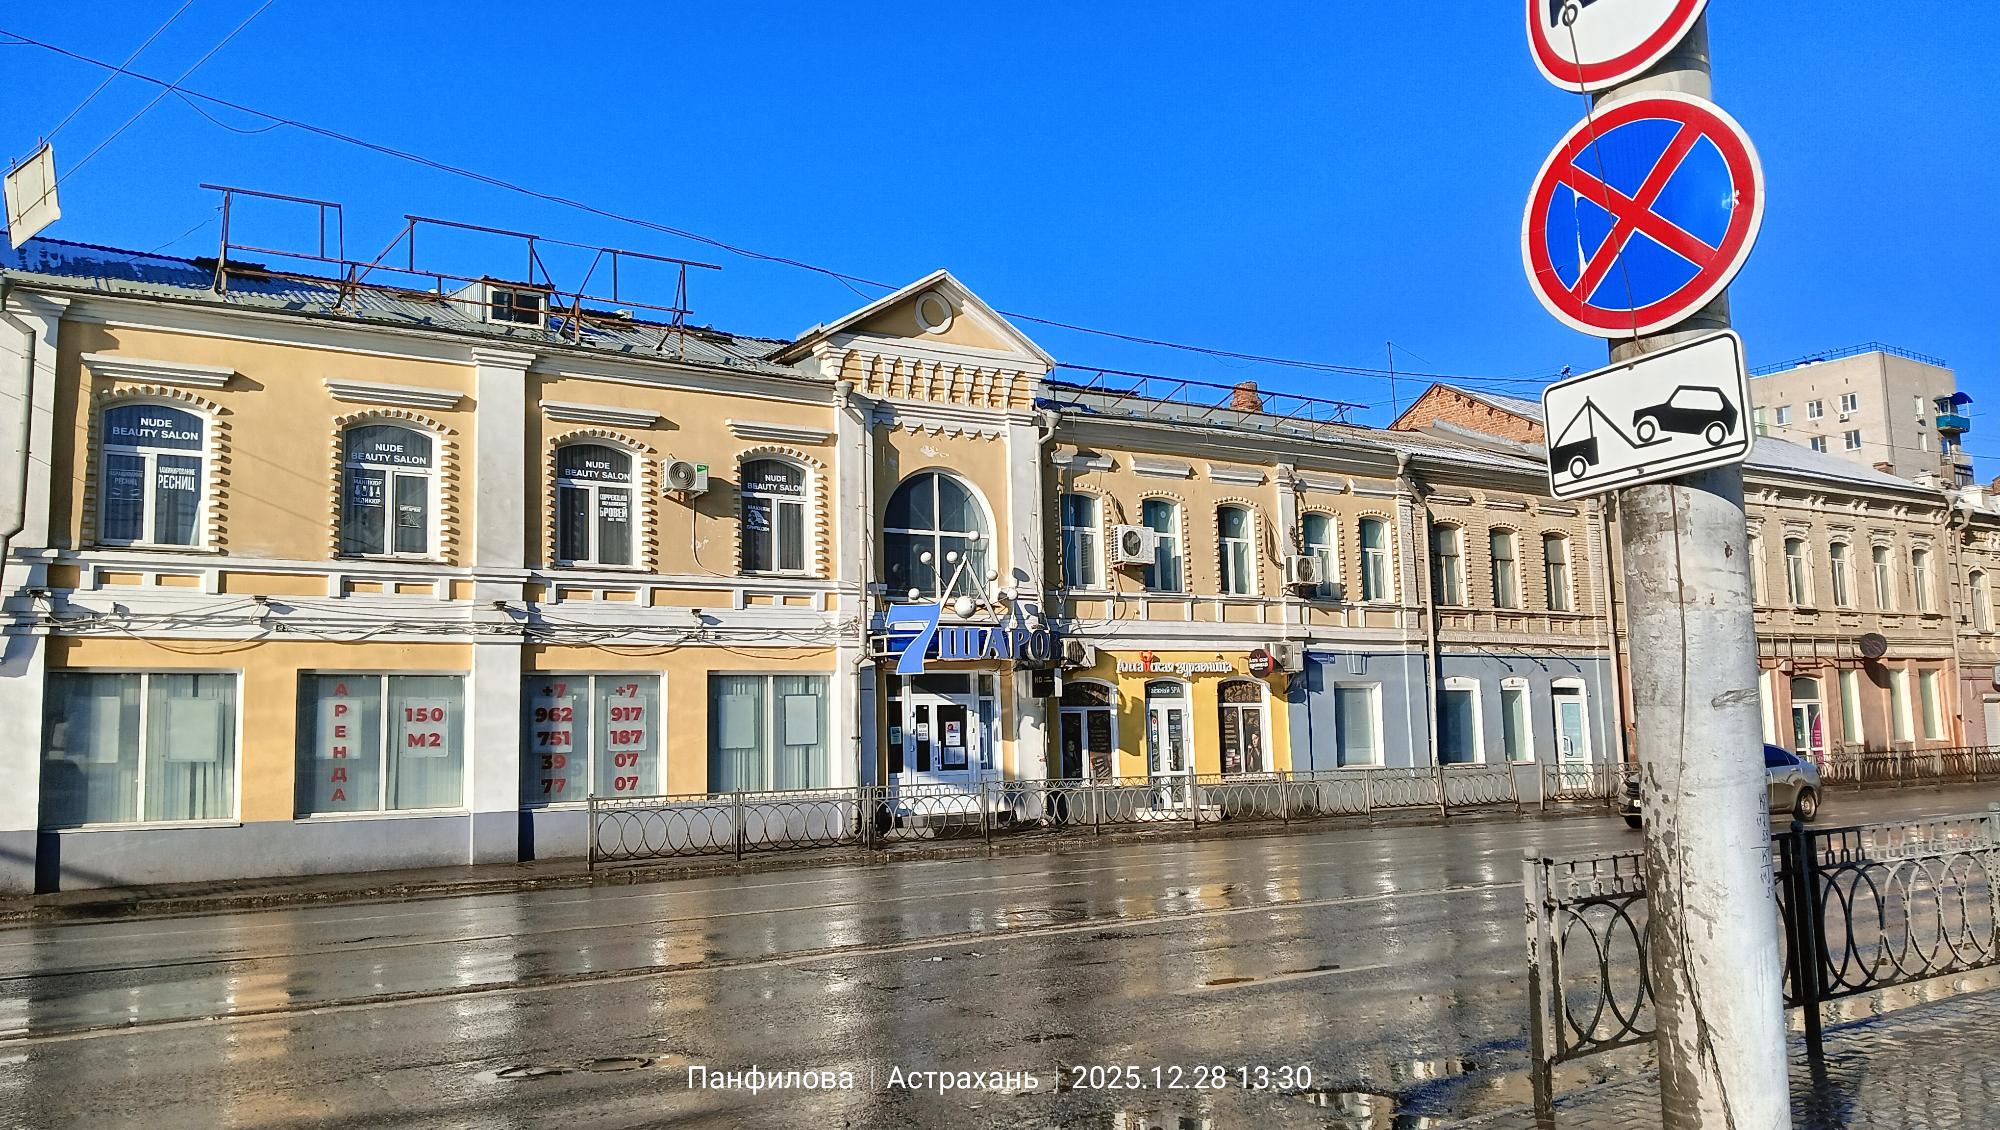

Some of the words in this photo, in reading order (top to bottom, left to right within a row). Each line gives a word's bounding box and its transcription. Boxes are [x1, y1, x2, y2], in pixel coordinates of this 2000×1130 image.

[141, 418, 172, 428] NUDE
[113, 427, 157, 438] BEAUTY
[161, 431, 198, 440] SALON
[376, 444, 403, 452] NUDE
[352, 453, 390, 462] BEAUTY
[394, 456, 426, 464] SALON
[586, 461, 610, 470] NUDE
[566, 469, 598, 478] BEAUTY
[602, 472, 630, 480] SALON
[158, 474, 195, 492] РЕСНИЦ
[600, 507, 627, 518] БРОВЕЙ
[885, 601, 942, 675] 7
[937, 626, 1063, 661] ШАРОВ
[542, 683, 567, 698] +7
[615, 684, 639, 698] +7
[1170, 686, 1181, 694] SPA
[405, 707, 444, 723] 150
[535, 707, 573, 723] 962
[611, 707, 643, 722] 917
[331, 681, 348, 802] АРЕНДА
[407, 732, 441, 748] М2
[537, 731, 571, 746] 751
[610, 729, 643, 745] 187
[542, 754, 566, 770] 39
[614, 753, 639, 768] 07
[541, 778, 567, 794] 77
[614, 776, 639, 791] 07
